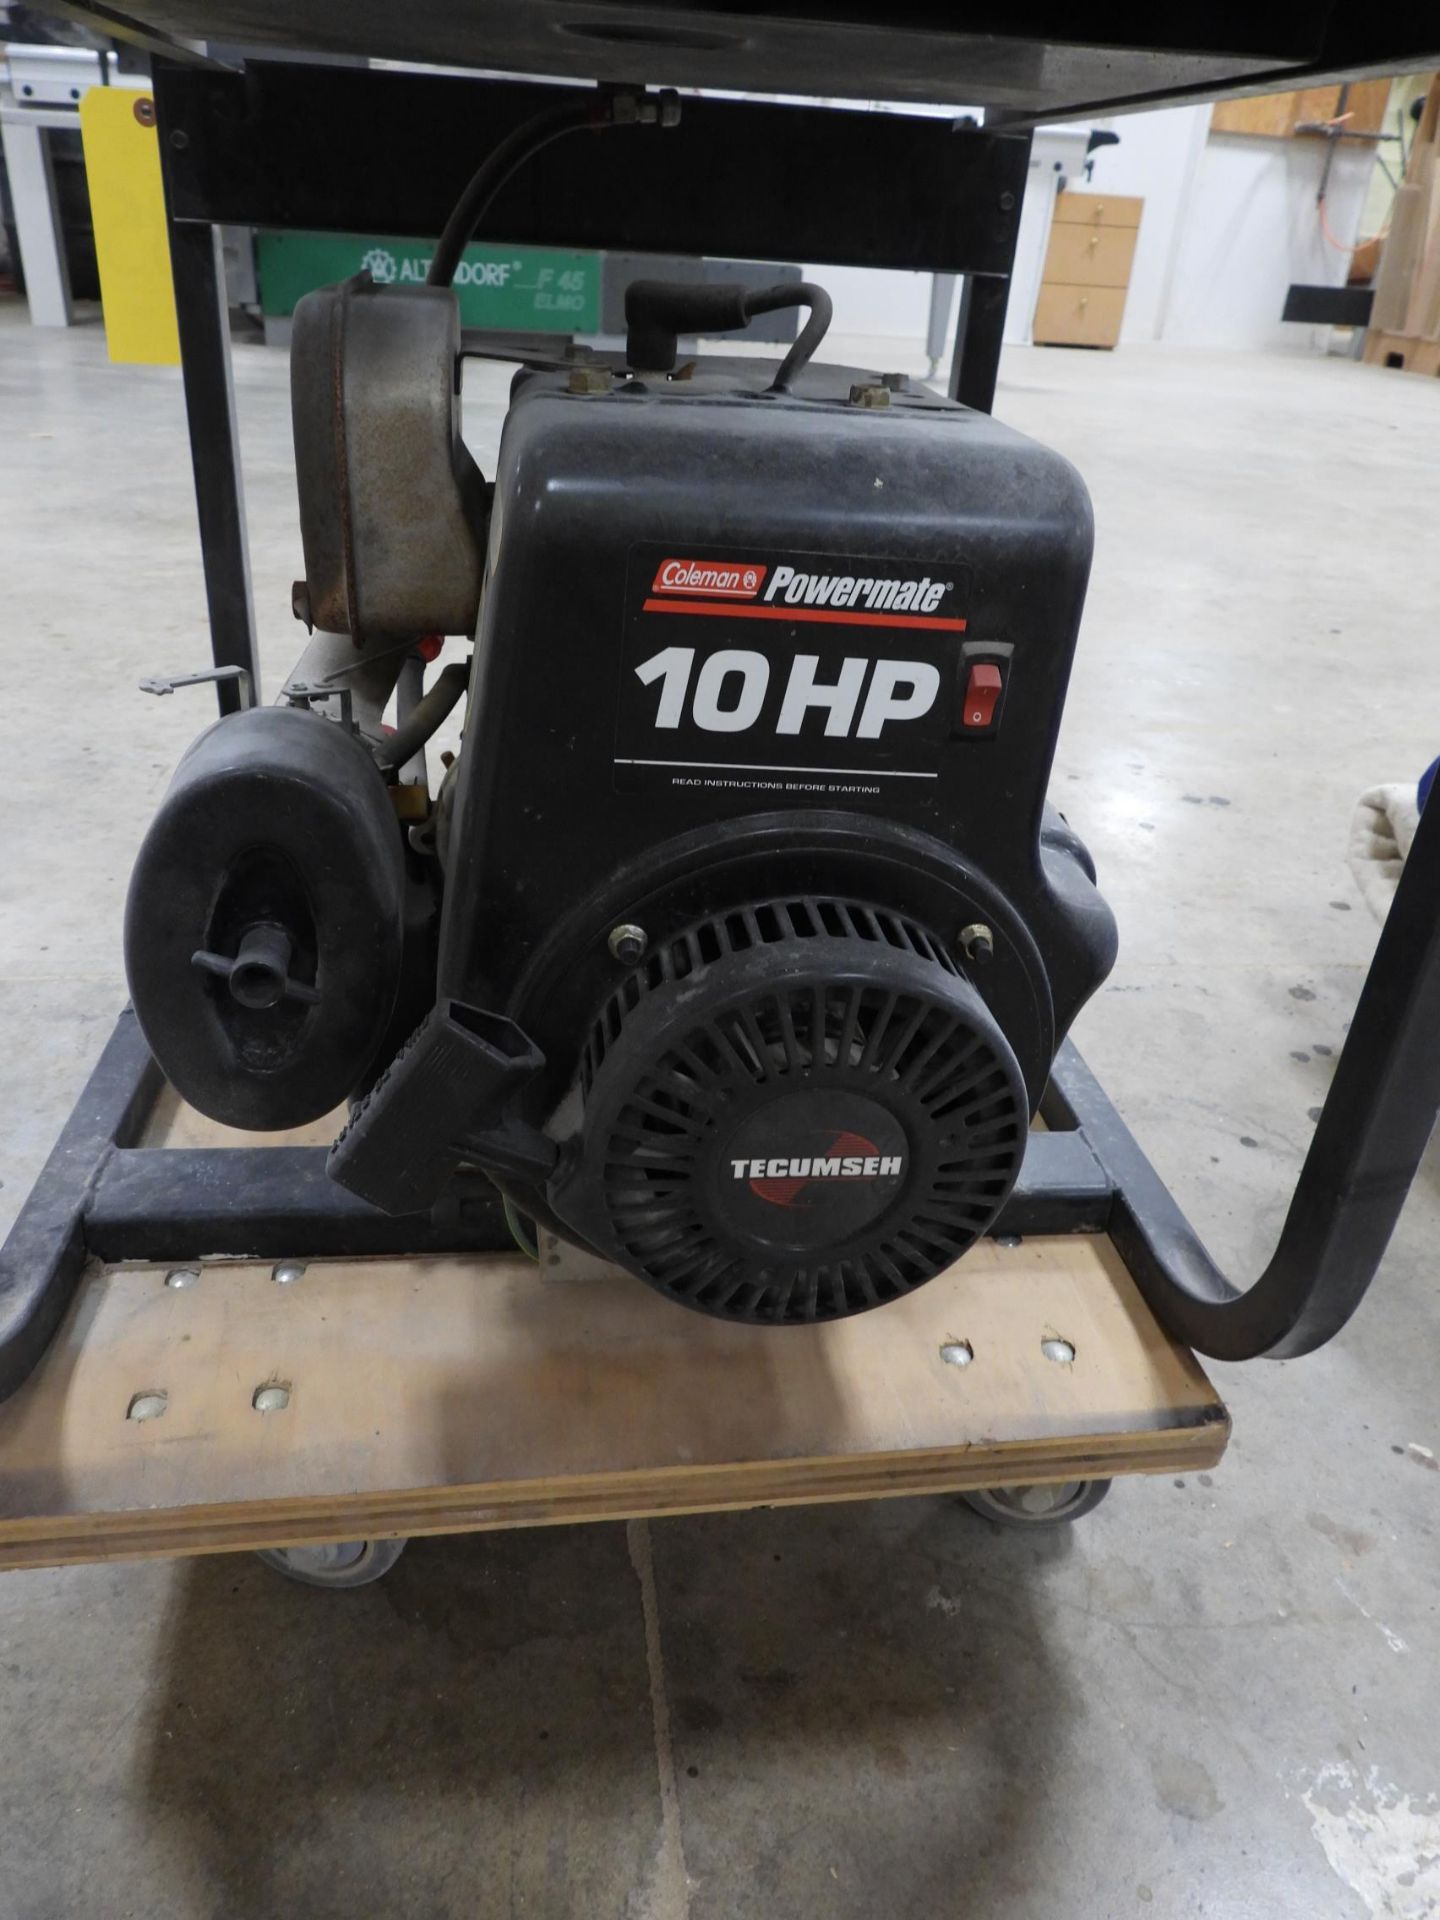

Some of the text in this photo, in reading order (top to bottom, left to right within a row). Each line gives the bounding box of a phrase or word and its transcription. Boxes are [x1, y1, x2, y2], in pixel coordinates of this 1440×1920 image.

[400, 258, 511, 286] ALTDORF
[661, 560, 741, 589] Coleman
[634, 646, 940, 739] 10 HP
[672, 777, 880, 794] READ INSTRUCTIONS BEFORE STARTING
[731, 1156, 902, 1179] TECUMSEH
